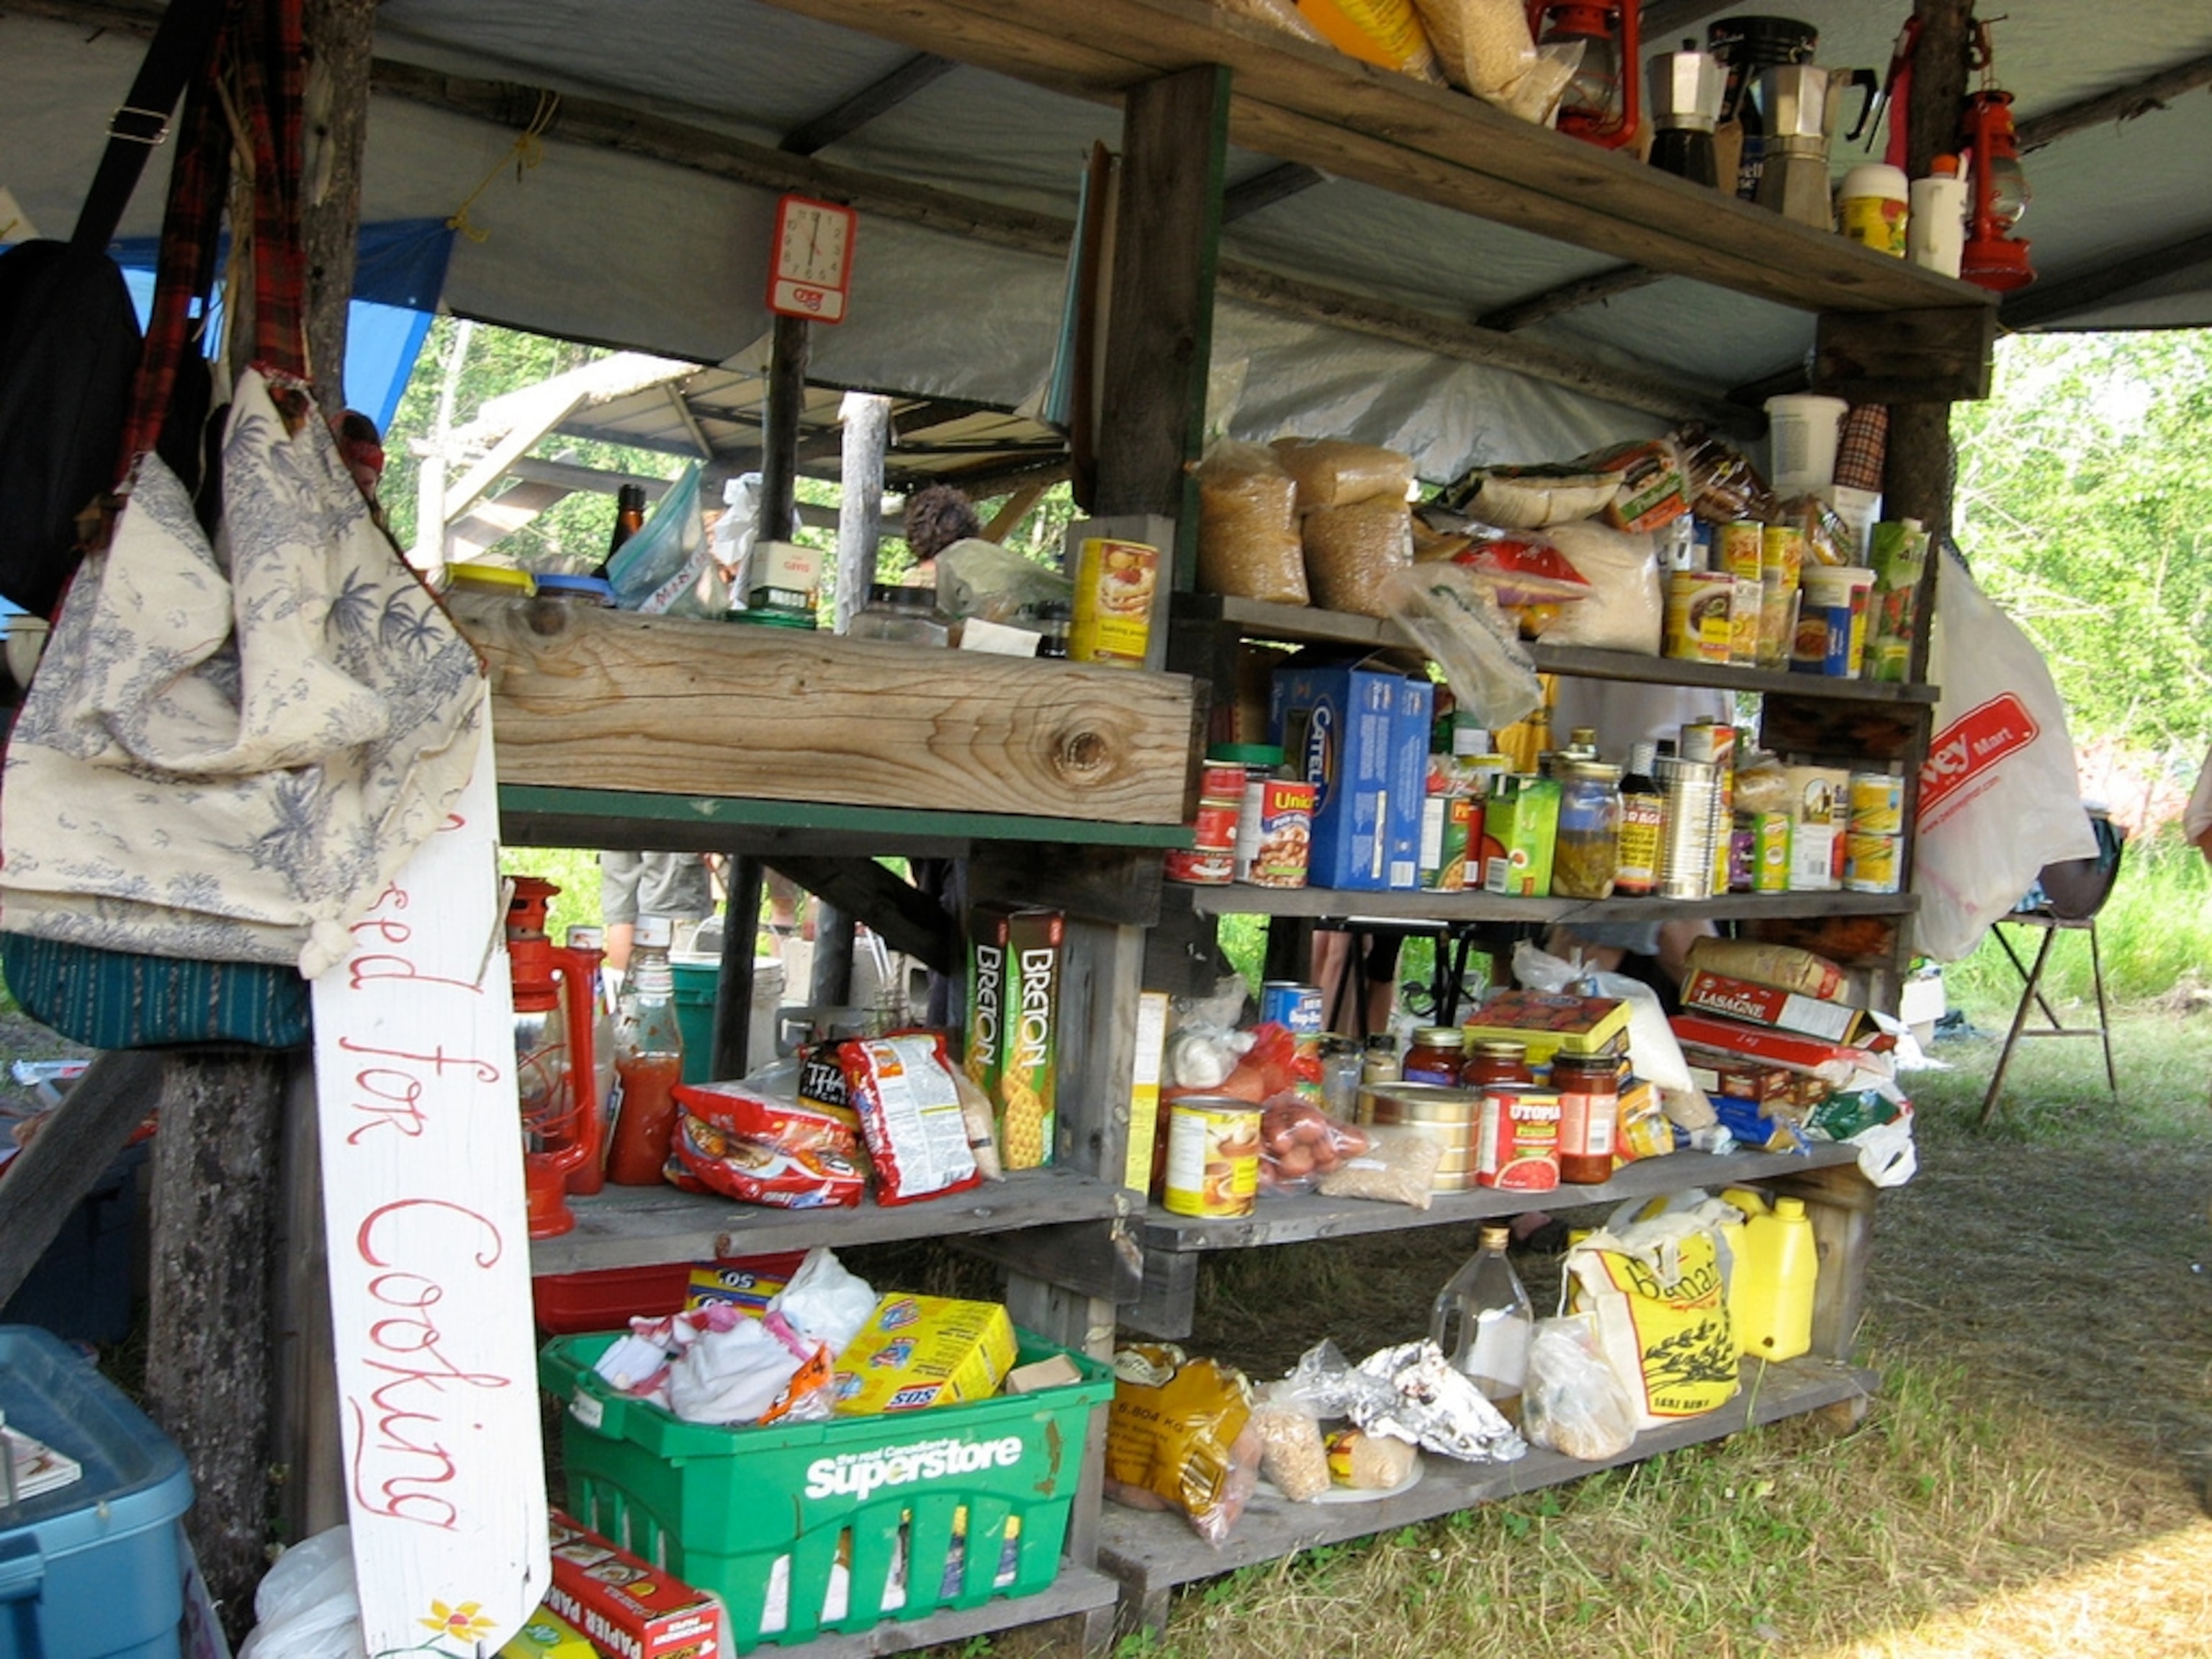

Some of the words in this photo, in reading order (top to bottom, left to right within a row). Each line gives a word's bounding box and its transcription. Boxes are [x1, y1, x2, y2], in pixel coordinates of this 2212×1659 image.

[1974, 727, 2013, 757] Mart
[976, 945, 1002, 1065] BRETON
[1021, 948, 1053, 1066] BRETON
[1697, 990, 1766, 1019] LASAGNE
[349, 1198, 511, 1532] Cooking
[894, 1389, 935, 1406] SOS
[805, 1437, 1022, 1501] Superstore
[584, 1608, 642, 1659] PAPIER
